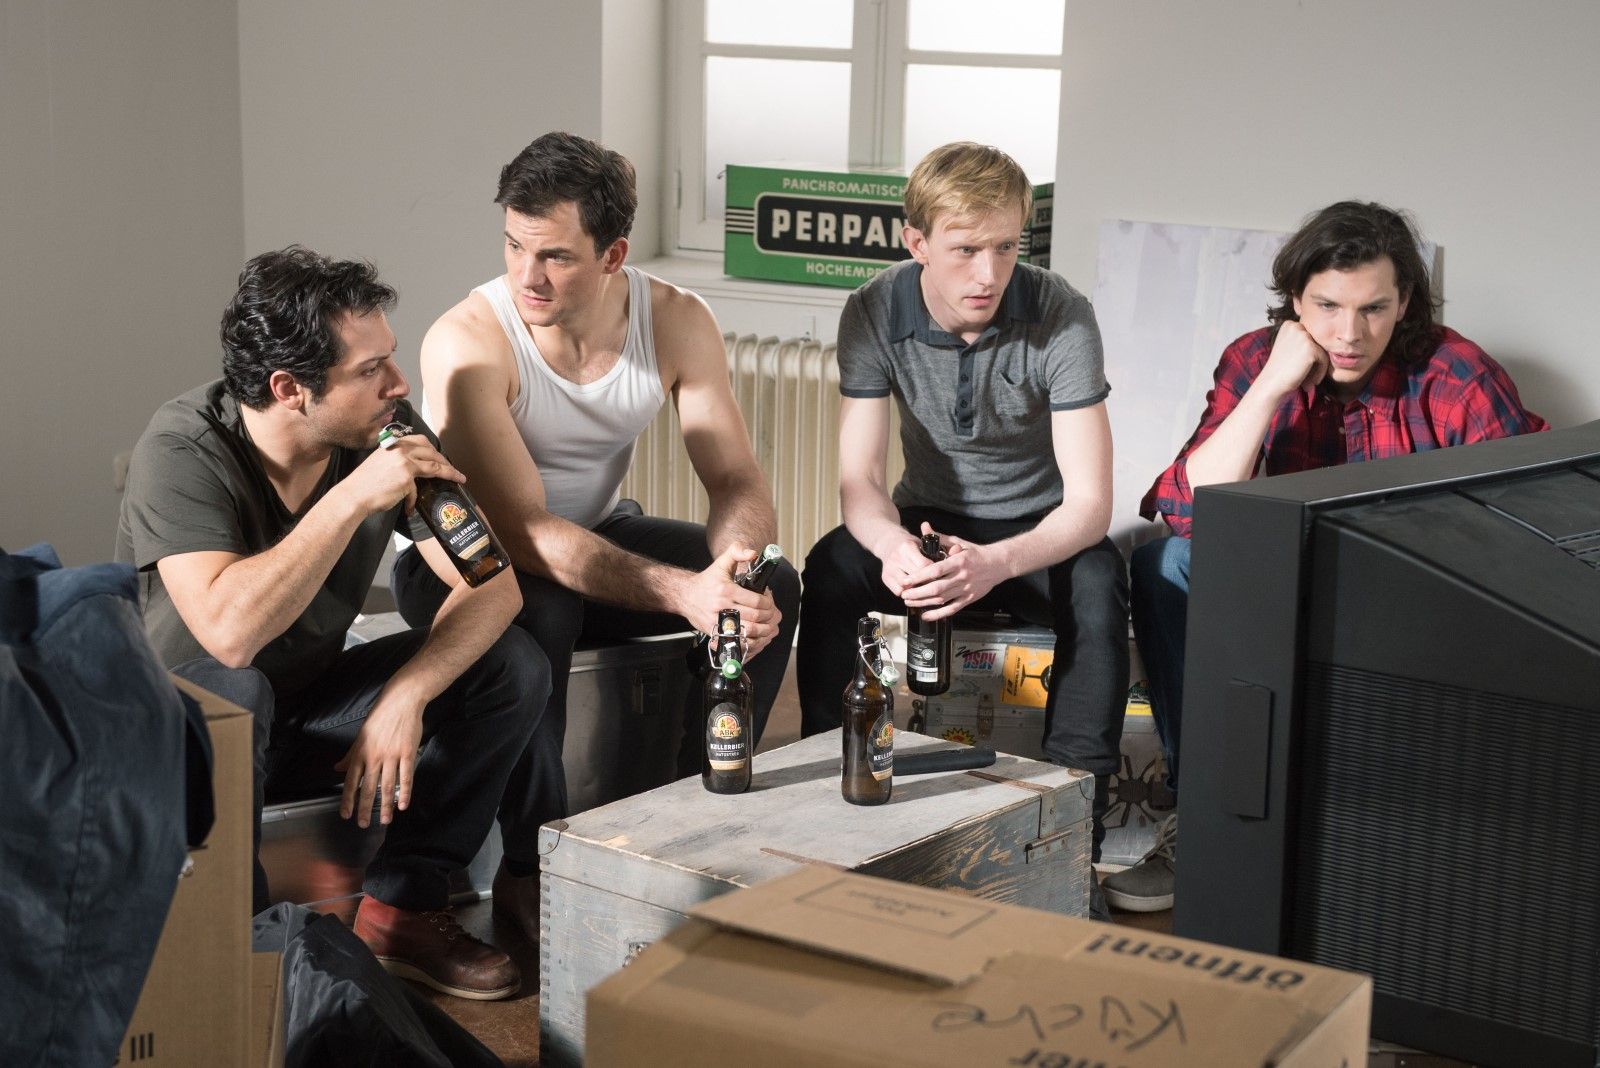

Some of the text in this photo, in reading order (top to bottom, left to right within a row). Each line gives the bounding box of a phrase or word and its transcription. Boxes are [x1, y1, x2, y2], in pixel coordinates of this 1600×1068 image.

[450, 521, 479, 545] KELLERBIER
[710, 743, 745, 751] KELLERBIER
[1084, 933, 1305, 991] öffnen!
